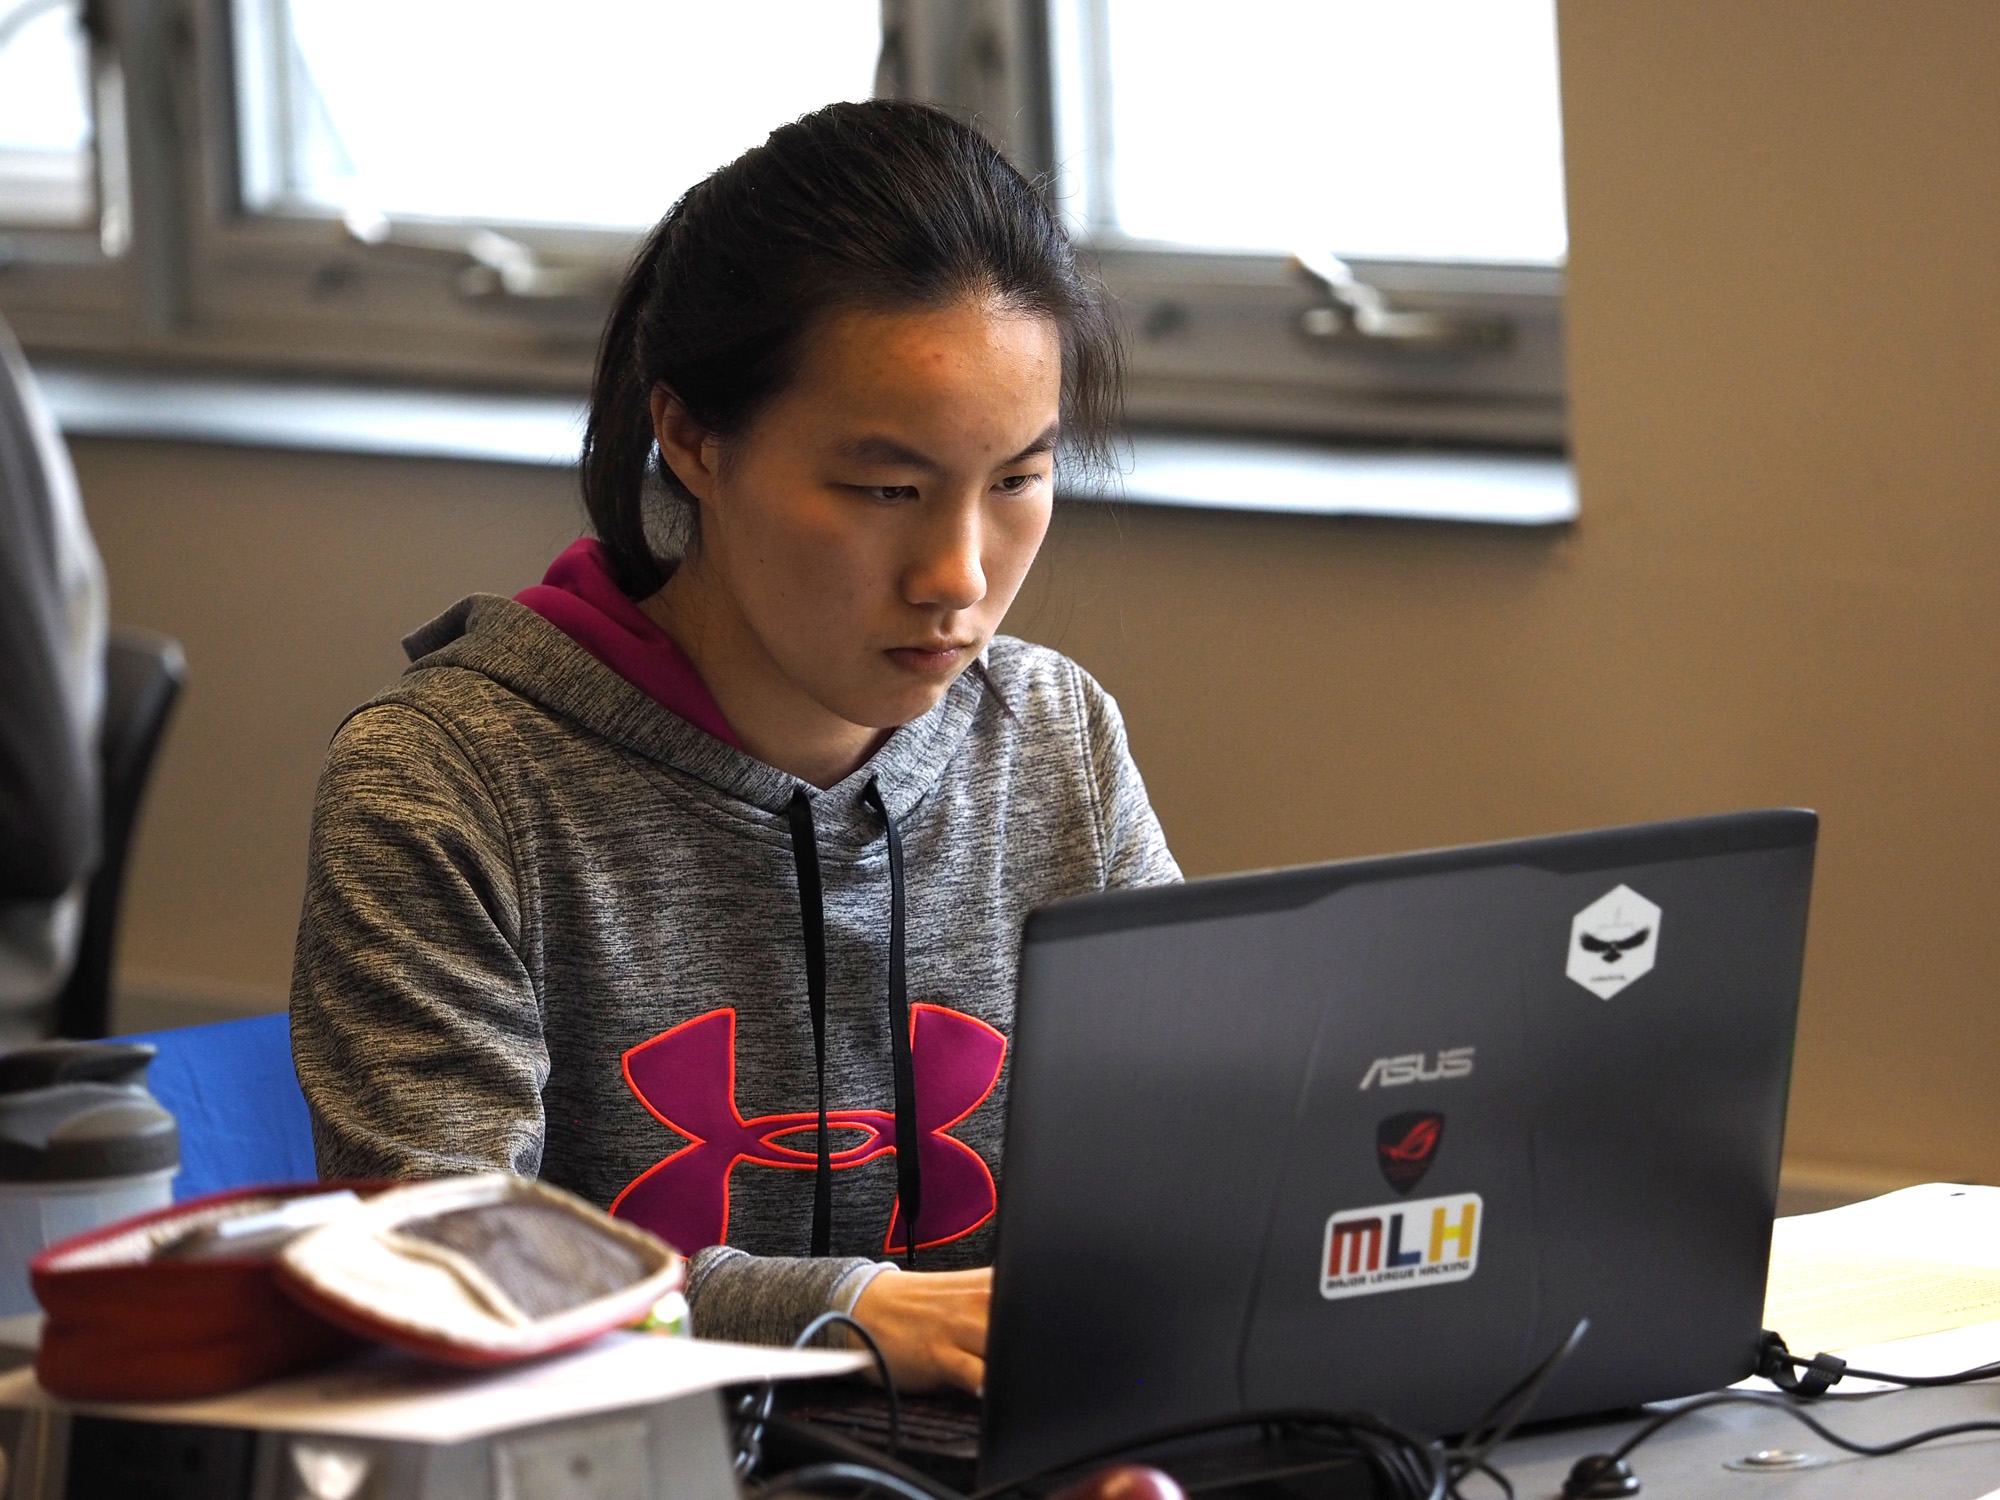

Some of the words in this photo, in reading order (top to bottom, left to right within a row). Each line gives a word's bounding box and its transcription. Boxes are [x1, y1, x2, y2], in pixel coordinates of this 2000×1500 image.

[1359, 1047, 1475, 1090] ASUS
[1327, 1276, 1366, 1289] MAJOR
[1371, 1268, 1414, 1283] LEAGUE
[1419, 1260, 1470, 1275] HACKING
